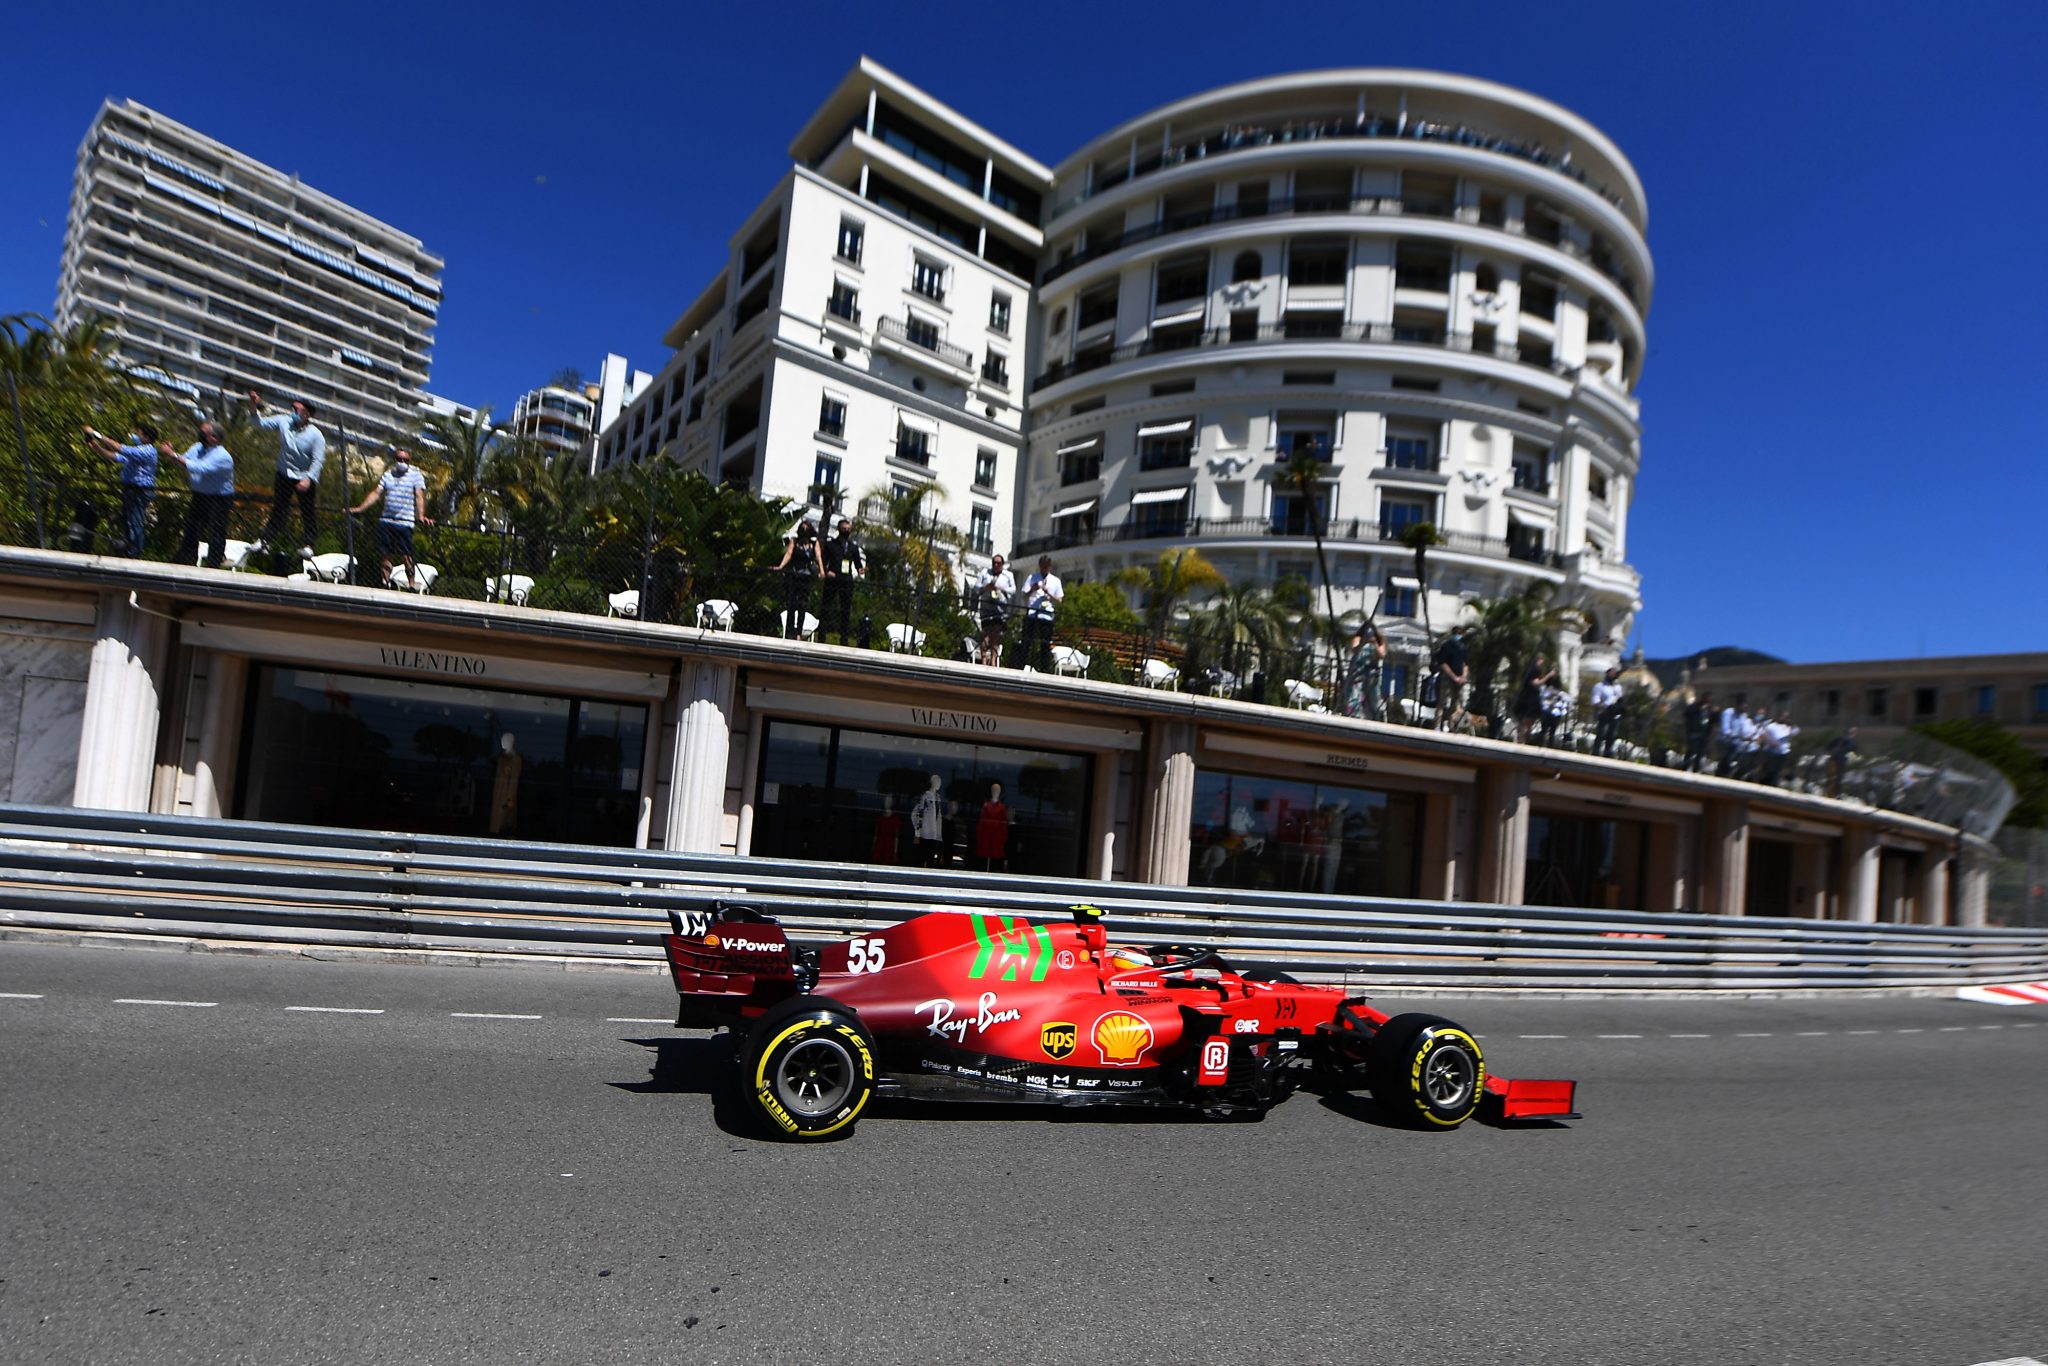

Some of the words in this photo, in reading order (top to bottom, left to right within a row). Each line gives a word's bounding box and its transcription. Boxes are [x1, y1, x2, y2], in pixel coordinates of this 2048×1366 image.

[380, 648, 486, 675] VALENTINO
[911, 708, 997, 732] VALENTINO
[721, 937, 786, 952] V-Power
[847, 939, 886, 975] 55
[914, 991, 1021, 1043] Ray-Ban
[813, 1019, 832, 1028] P
[836, 1025, 873, 1080] ZERO
[1043, 1031, 1074, 1054] ups
[986, 1071, 1018, 1083] brembo
[1411, 1038, 1434, 1092] ZERO
[1026, 1075, 1048, 1086] NGK
[1076, 1079, 1101, 1087] SKF
[759, 1089, 799, 1133] PIRELLI
